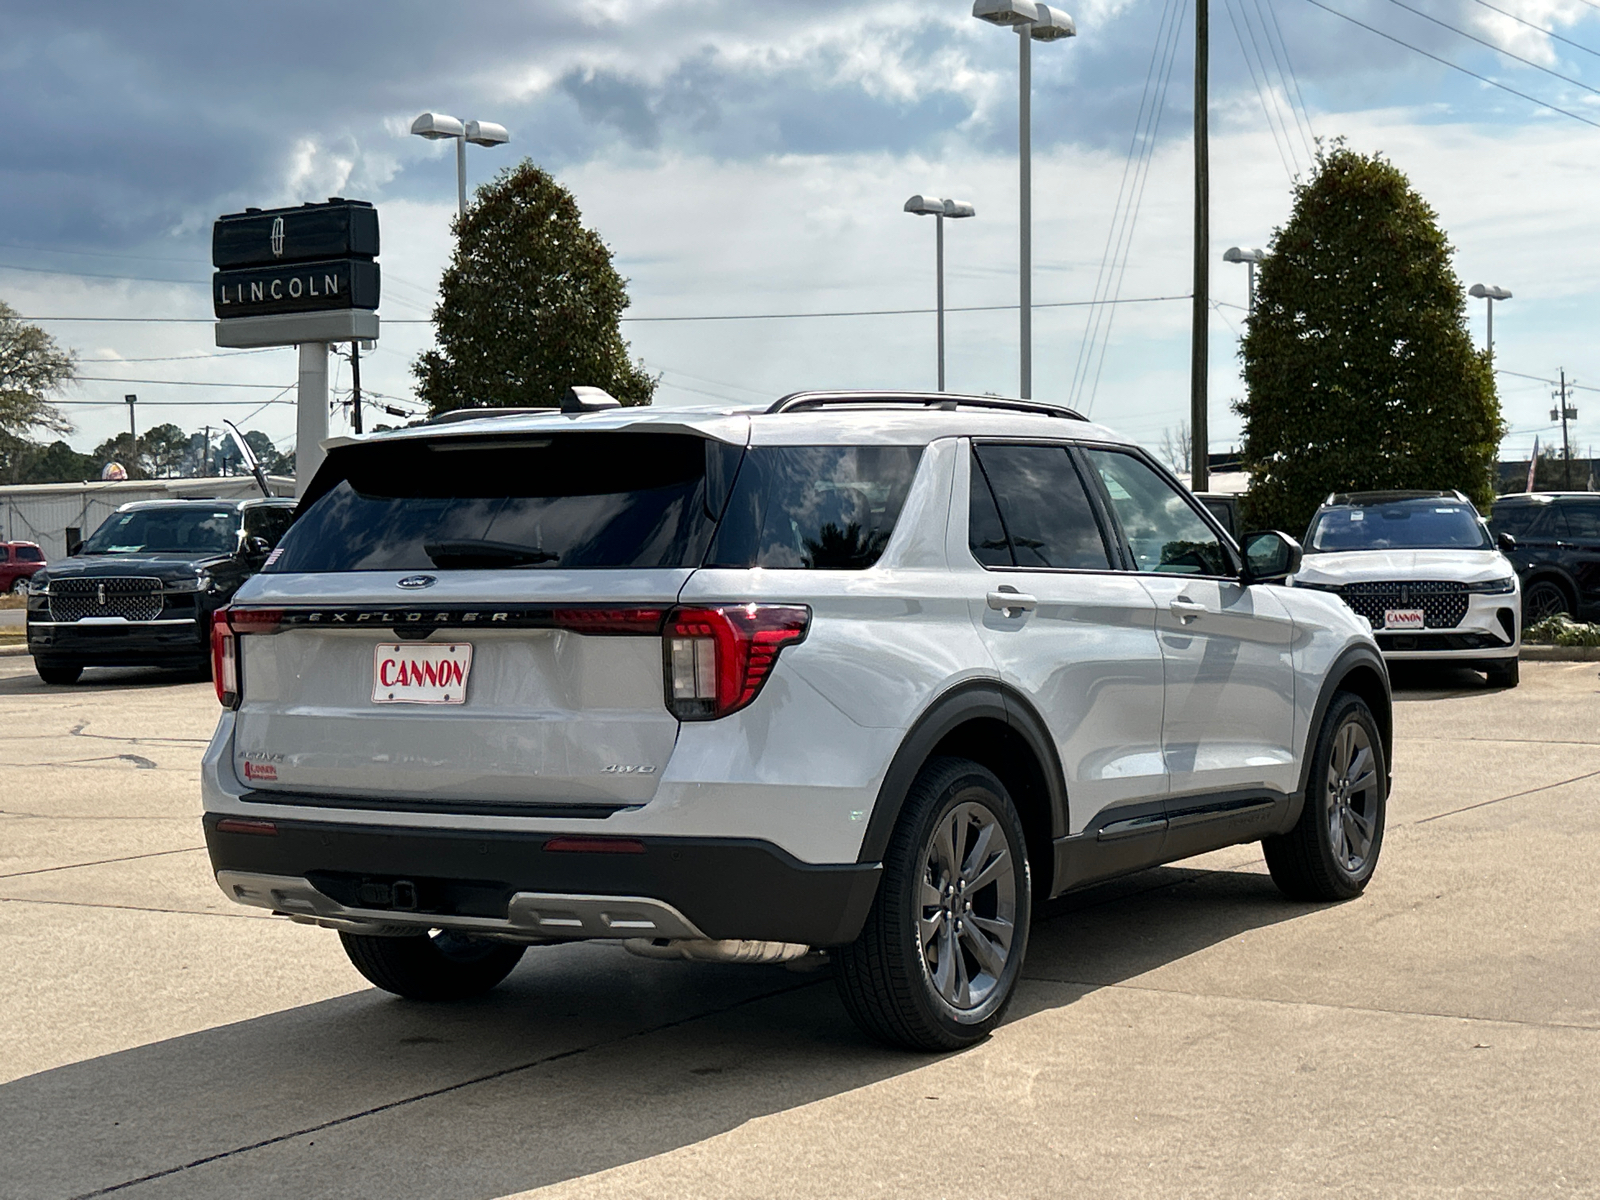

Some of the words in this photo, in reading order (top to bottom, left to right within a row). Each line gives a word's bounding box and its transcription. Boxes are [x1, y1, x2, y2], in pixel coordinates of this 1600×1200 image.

[221, 274, 339, 304] LINCOLN
[308, 612, 508, 622] EXPLORER
[1387, 613, 1422, 623] CANNON
[380, 658, 467, 687] CANNON
[600, 764, 657, 774] 4WD
